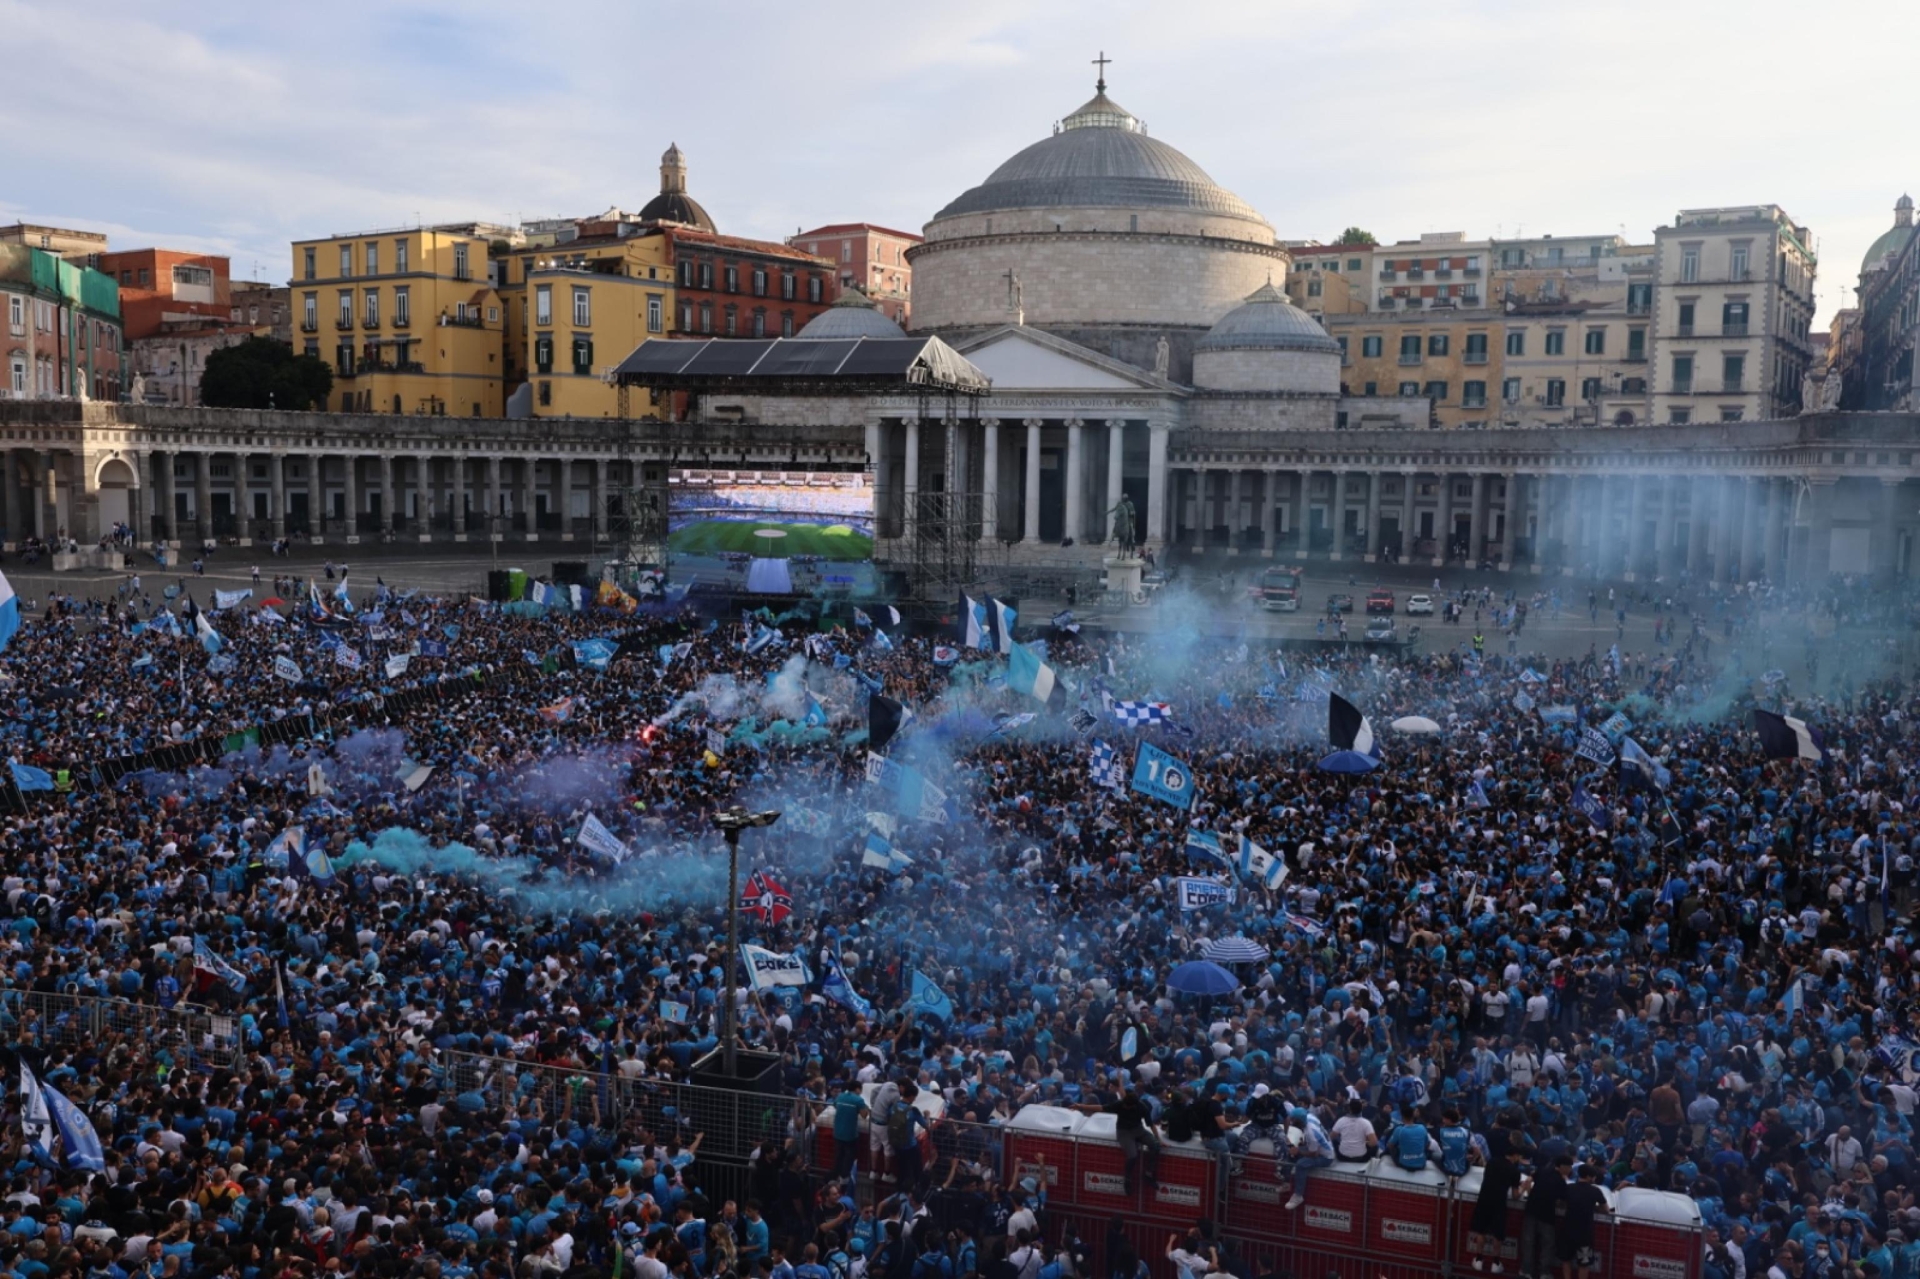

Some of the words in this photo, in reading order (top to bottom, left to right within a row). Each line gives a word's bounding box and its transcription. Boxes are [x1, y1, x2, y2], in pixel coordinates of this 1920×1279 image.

[1187, 893, 1227, 905] CORE
[754, 960, 800, 971] CORE
[1100, 1177, 1124, 1185] SEBAC
[1319, 1211, 1349, 1221] SEBACH
[1397, 1224, 1428, 1234] SEBACH
[1650, 1262, 1684, 1272] SEBACH
